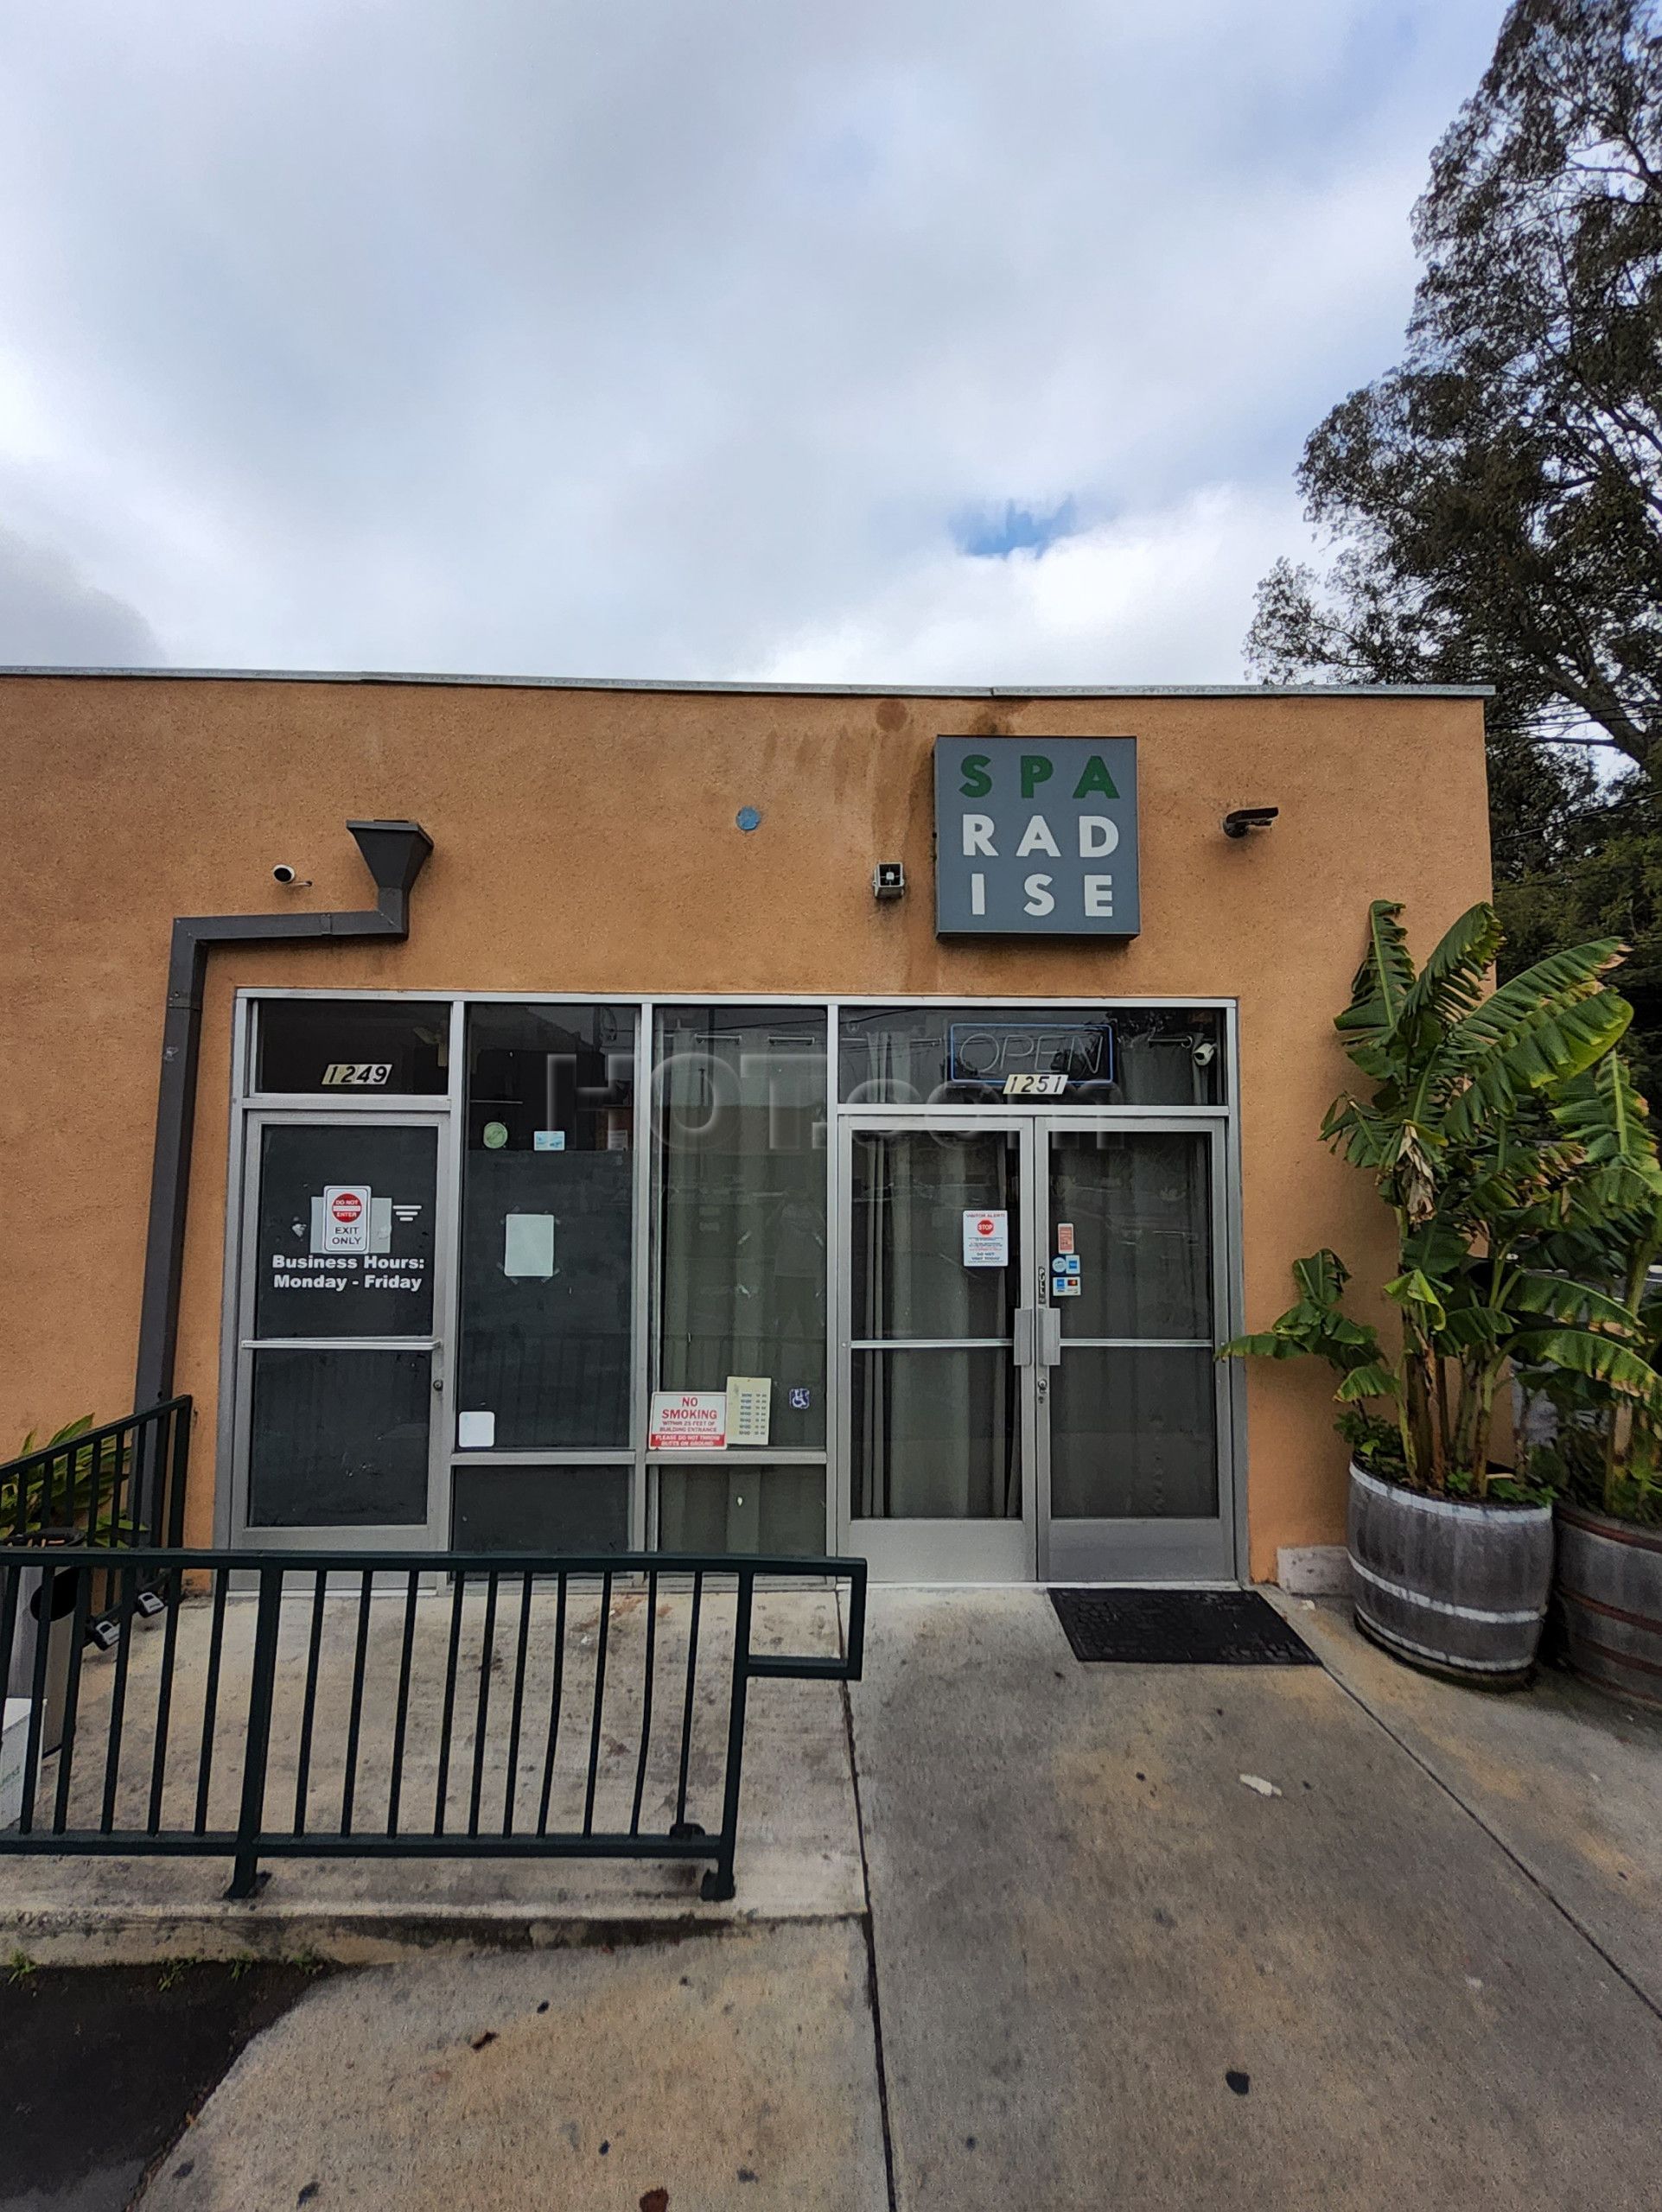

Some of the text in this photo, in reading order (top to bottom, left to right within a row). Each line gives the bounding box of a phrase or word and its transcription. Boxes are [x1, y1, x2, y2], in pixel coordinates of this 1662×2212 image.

[958, 754, 1120, 799] SPA
[963, 814, 1119, 857] RAD
[971, 874, 1113, 917] ISE
[959, 1033, 1104, 1073] OPEN
[328, 1065, 388, 1084] 1249
[1009, 1076, 1062, 1093] 1251
[332, 1236, 361, 1245] ONLY
[272, 1255, 424, 1269] Business Hours:
[273, 1274, 347, 1292] Monday
[364, 1274, 422, 1292] Friday
[682, 1396, 698, 1407] NO
[662, 1409, 717, 1420] SMOKING
